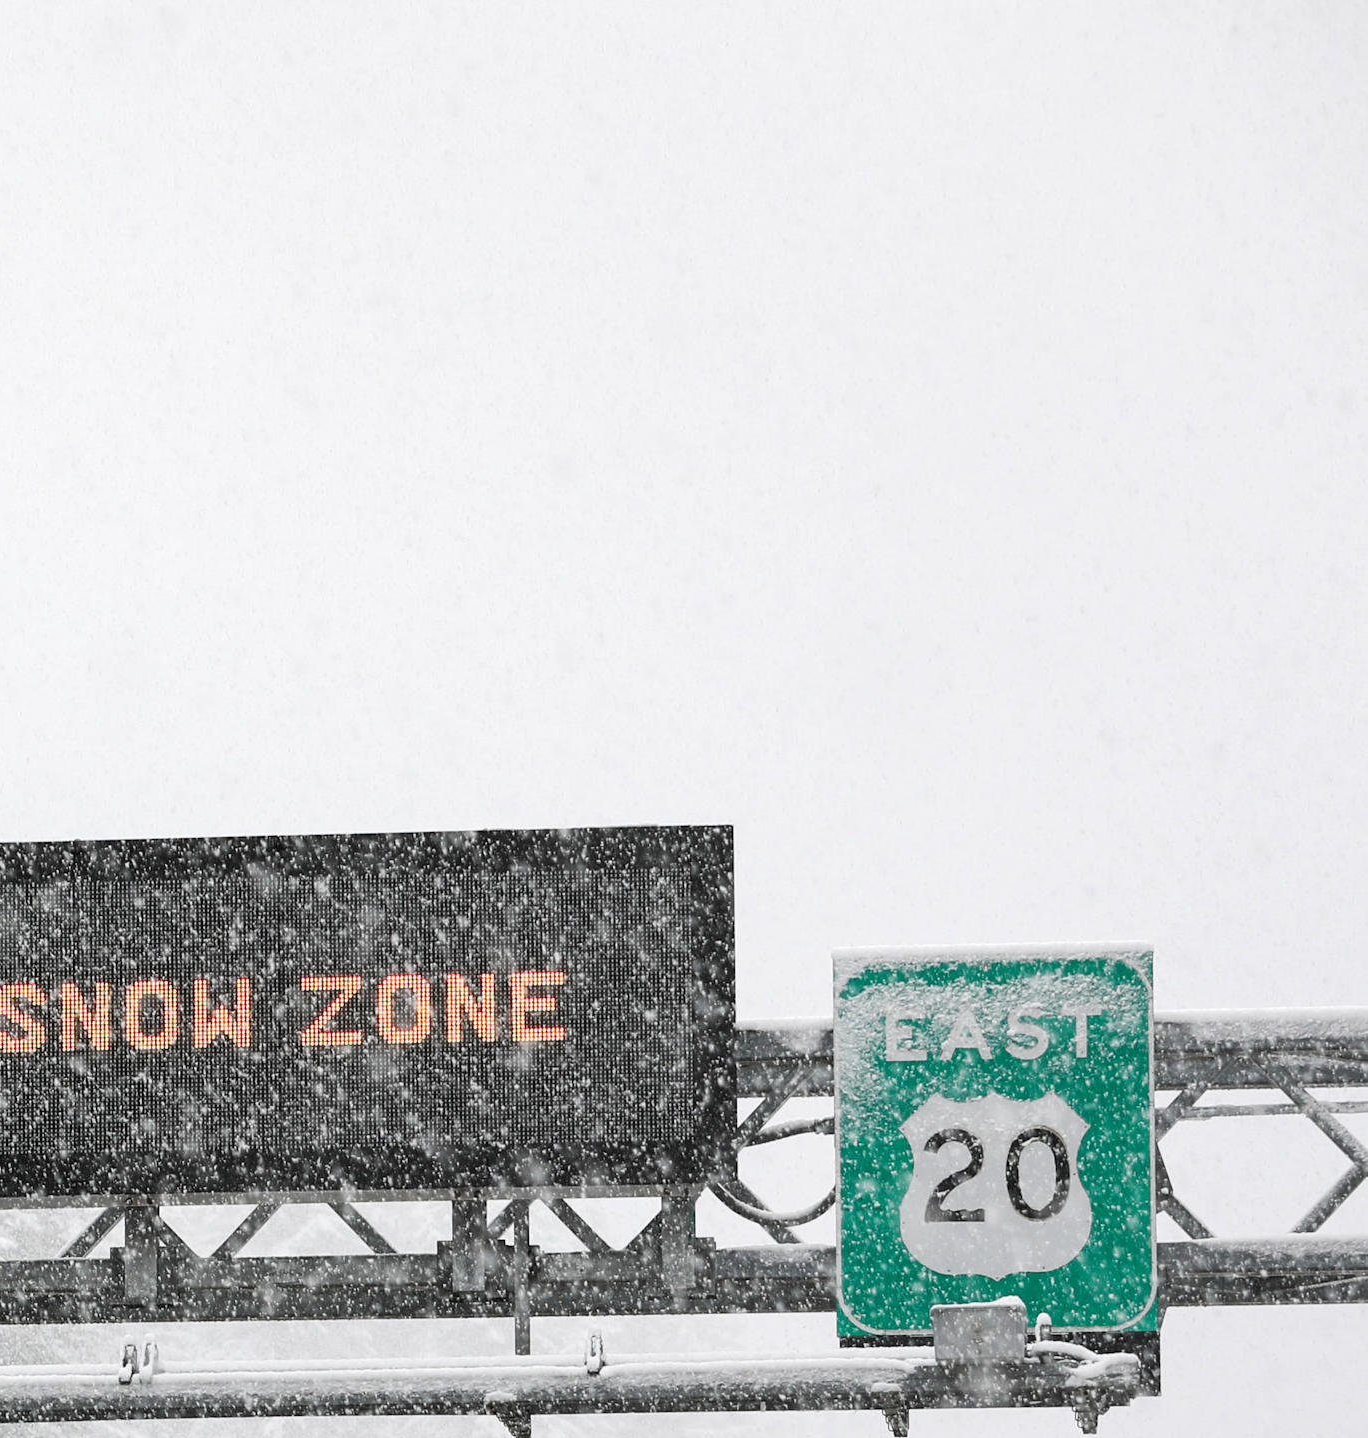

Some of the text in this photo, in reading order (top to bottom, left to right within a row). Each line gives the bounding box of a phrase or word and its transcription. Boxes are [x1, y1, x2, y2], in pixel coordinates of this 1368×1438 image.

[298, 969, 568, 1047] ZONE
[884, 1002, 1104, 1063] EAST
[923, 1125, 1071, 1224] 20
